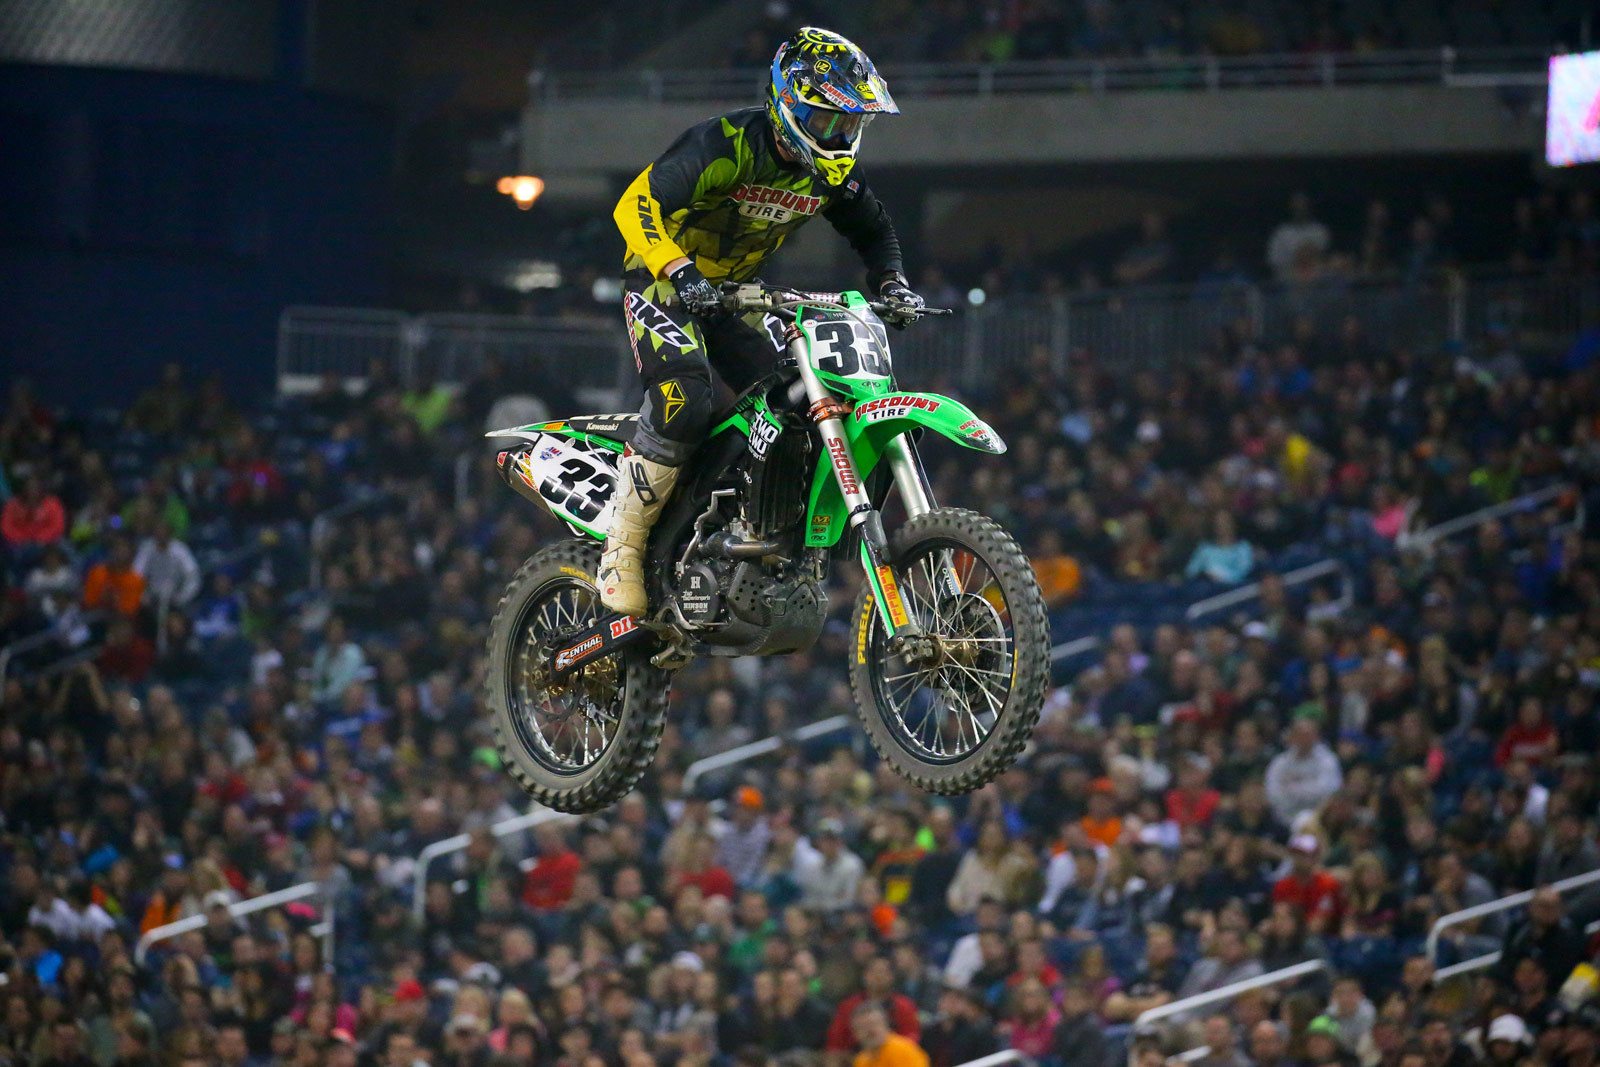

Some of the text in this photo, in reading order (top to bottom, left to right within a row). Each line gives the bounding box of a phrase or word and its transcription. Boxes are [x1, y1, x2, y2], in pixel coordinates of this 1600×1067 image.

[731, 184, 820, 214] DSCOUNT
[746, 205, 785, 220] TIRE
[815, 322, 890, 376] 33
[586, 422, 620, 431] Kawasaki
[856, 395, 940, 422] DISCOUNT
[872, 408, 906, 420] TIRE
[828, 437, 859, 495] SHOWA
[540, 458, 619, 522] 33
[879, 566, 901, 625] PIRELLI
[857, 594, 874, 664] PIRELLI
